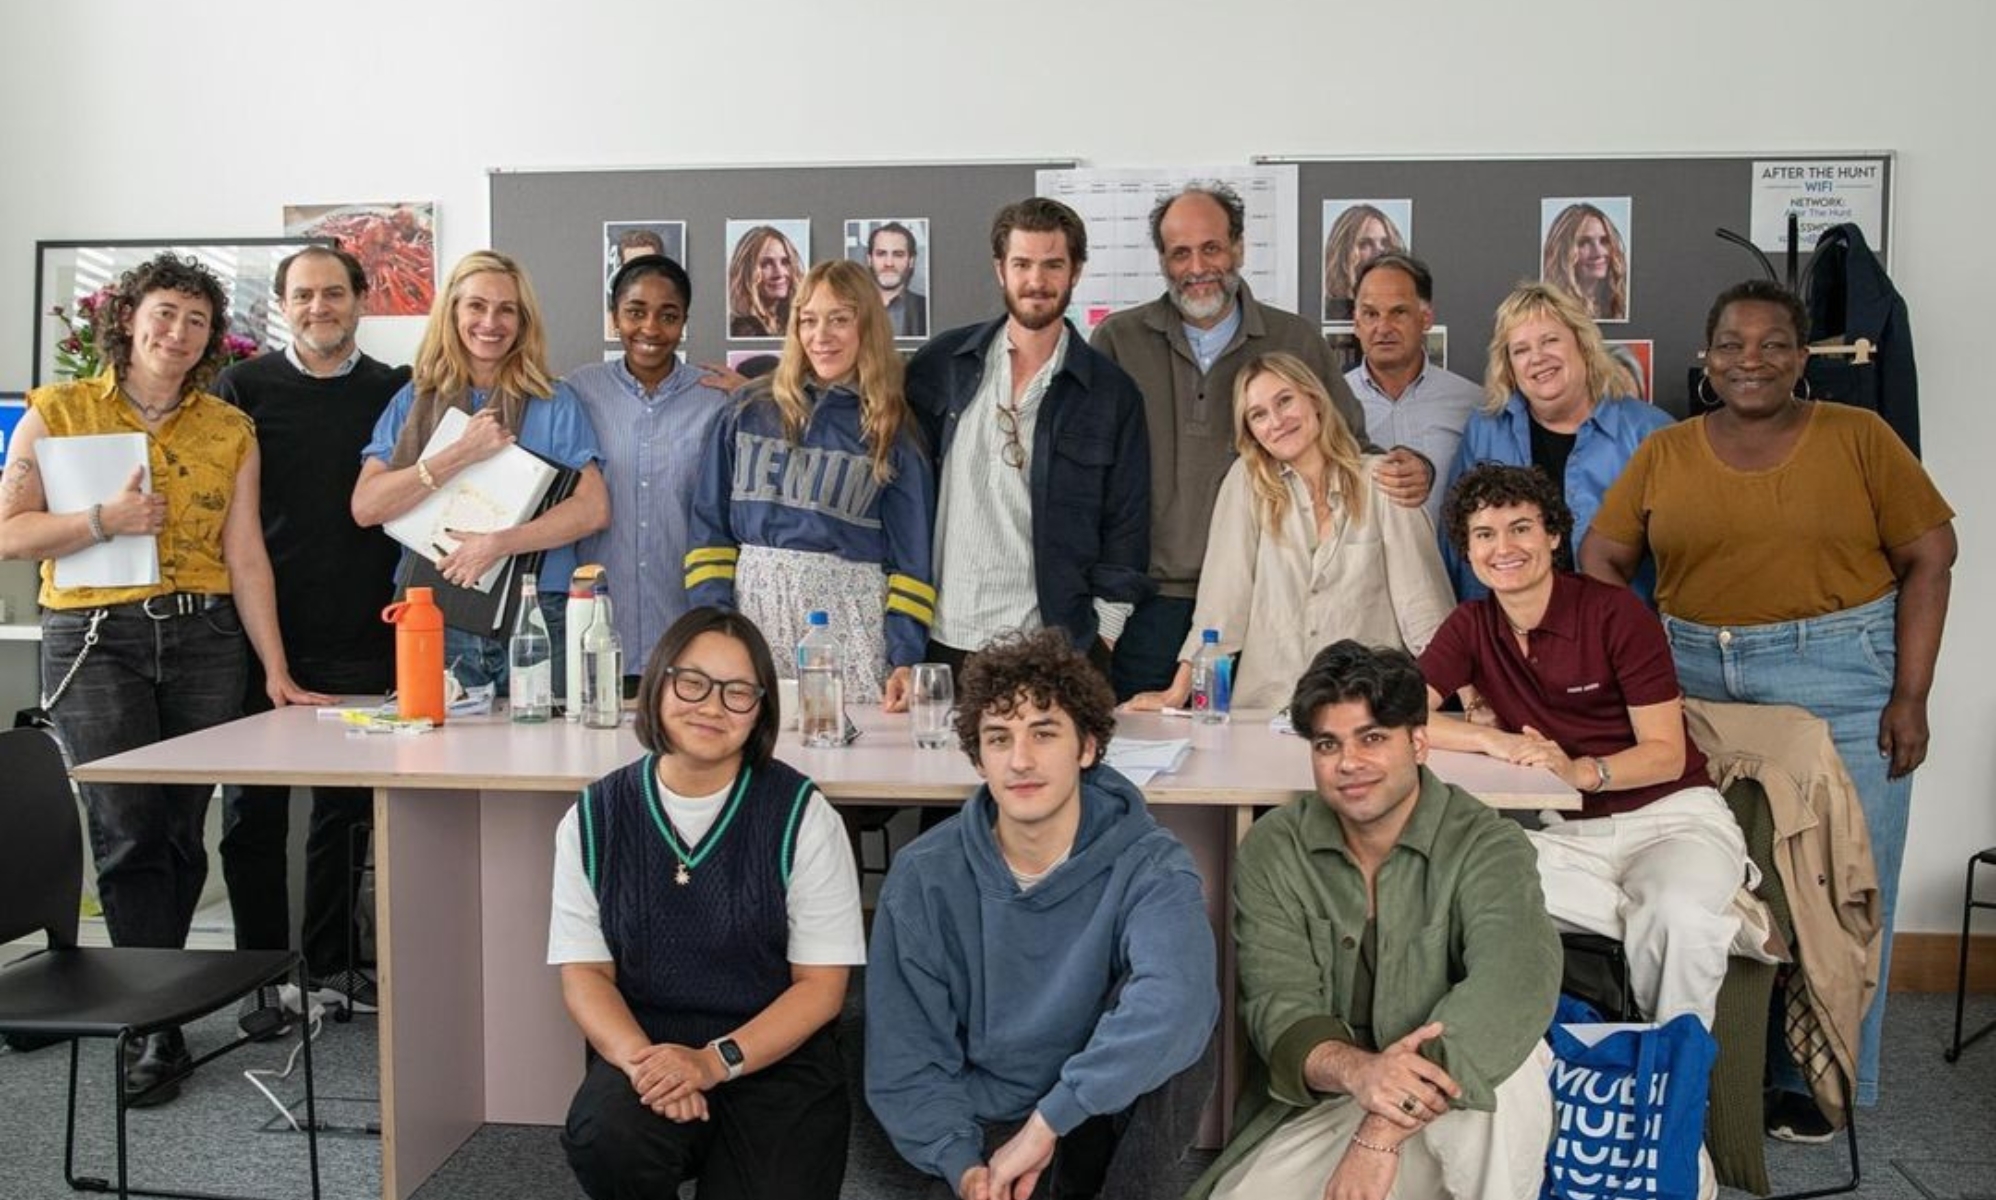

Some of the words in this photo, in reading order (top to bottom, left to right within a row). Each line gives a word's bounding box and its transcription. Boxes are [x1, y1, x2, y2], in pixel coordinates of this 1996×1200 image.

[1762, 167, 1805, 179] AFTER
[1808, 167, 1835, 178] THE
[1838, 166, 1877, 178] HUNT
[1805, 181, 1833, 192] WIFI
[1809, 208, 1827, 217] The
[1829, 208, 1852, 217] Hunt
[1548, 1058, 1669, 1106] MOBI
